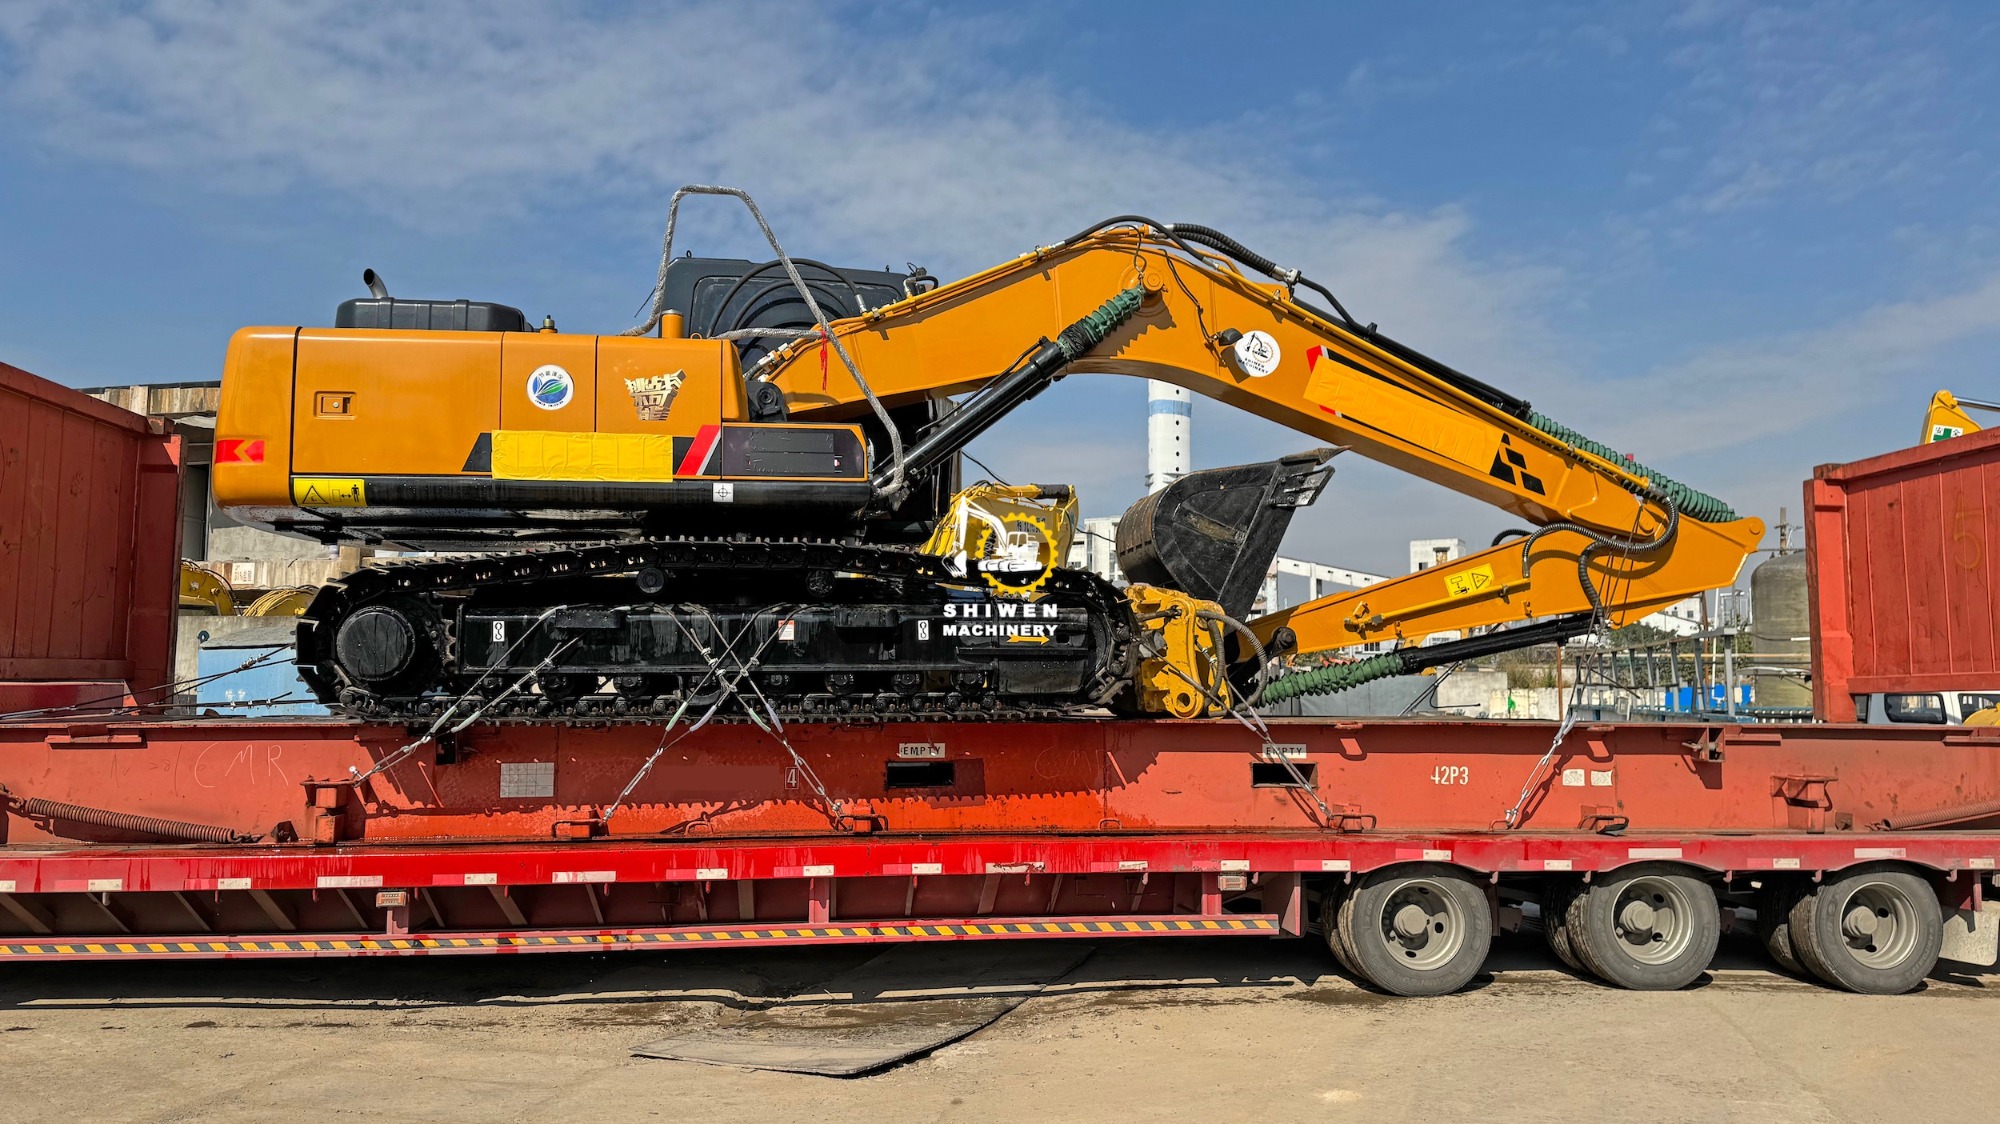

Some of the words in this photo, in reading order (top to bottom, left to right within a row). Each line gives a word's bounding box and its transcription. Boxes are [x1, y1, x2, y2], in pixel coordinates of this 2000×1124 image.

[623, 369, 686, 393] 挑战
[903, 746, 941, 756] EMPTY
[786, 768, 798, 788] 4
[1430, 765, 1469, 785] 42P3
